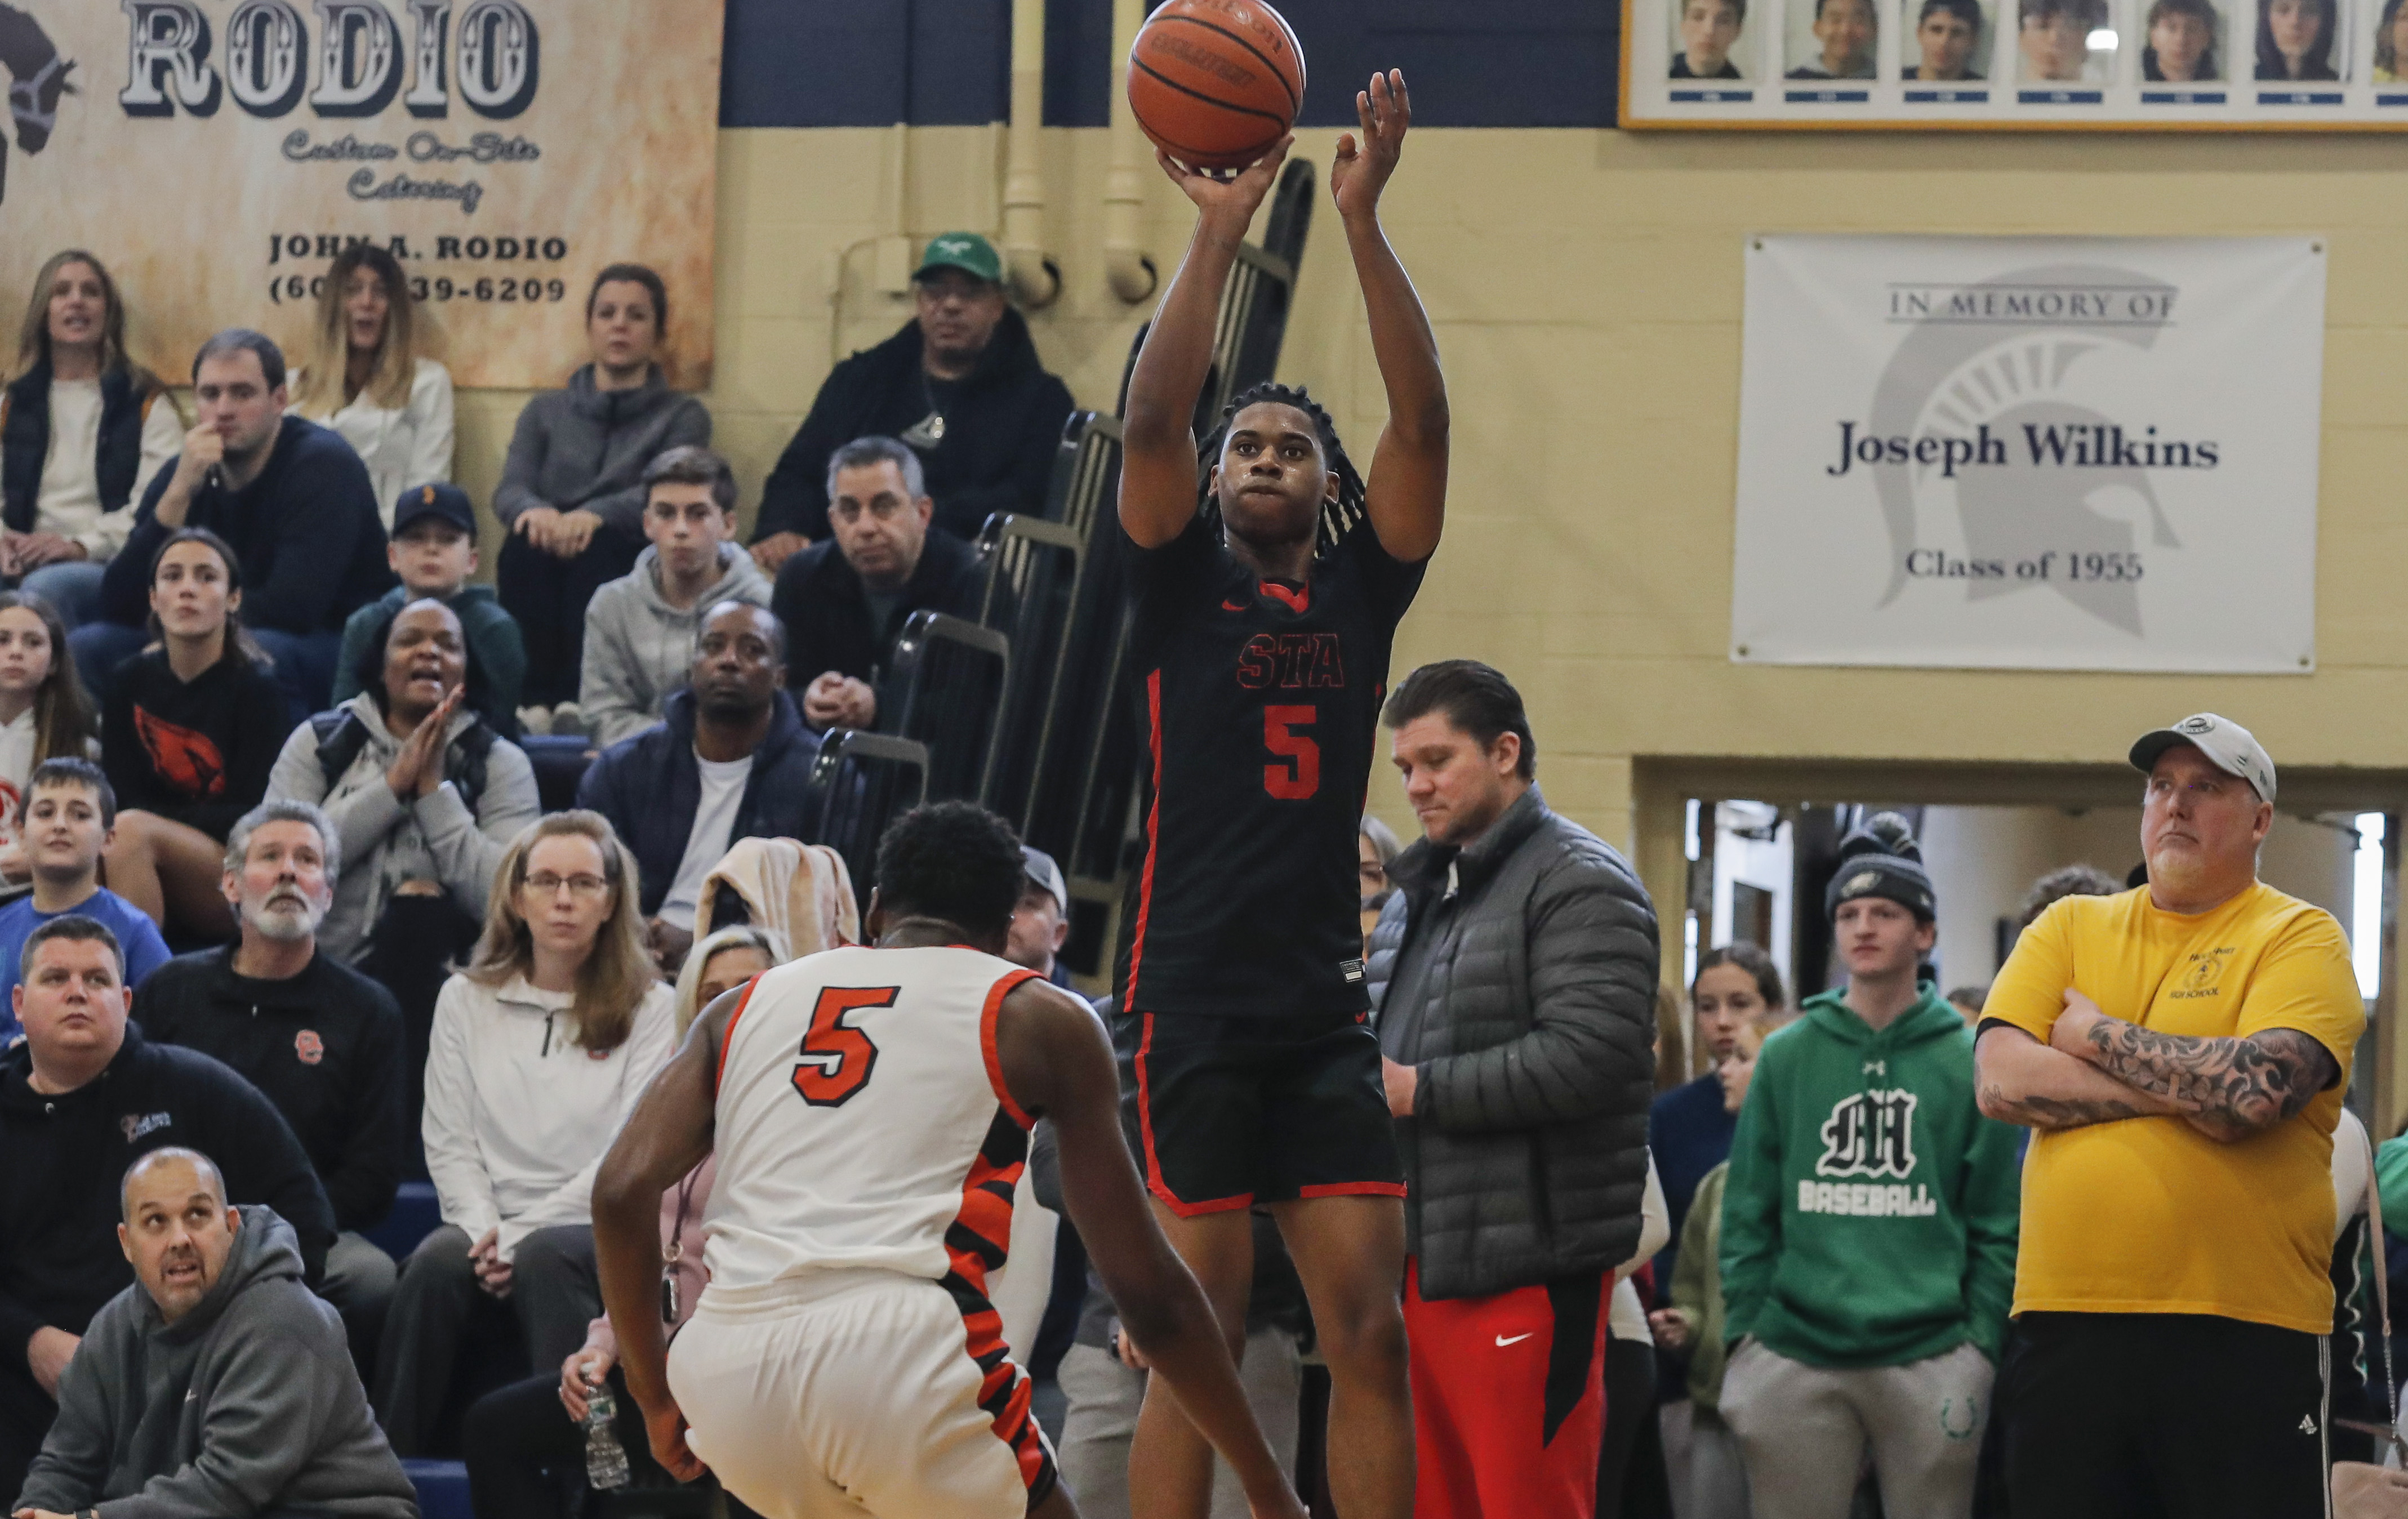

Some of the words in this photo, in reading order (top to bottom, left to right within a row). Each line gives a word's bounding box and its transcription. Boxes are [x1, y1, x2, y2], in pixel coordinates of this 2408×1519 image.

[119, 0, 539, 119] RODIO
[282, 128, 398, 163] Custom
[406, 130, 540, 164] On-Site
[347, 168, 483, 215] Catering
[436, 235, 566, 260] RODIO
[1891, 292, 1930, 314] IN
[1951, 292, 2112, 317] MEMORY
[2127, 293, 2176, 318] OF
[1826, 420, 2008, 477] Joseph
[2022, 424, 2219, 468] Wilkins
[1906, 549, 2005, 578] Class
[2015, 550, 2058, 581] of
[2069, 551, 2143, 582] 1955
[1236, 633, 1345, 689] STA
[1263, 705, 1320, 800] 5
[791, 986, 901, 1108] 5
[1799, 1179, 1937, 1217] BASEBALL
